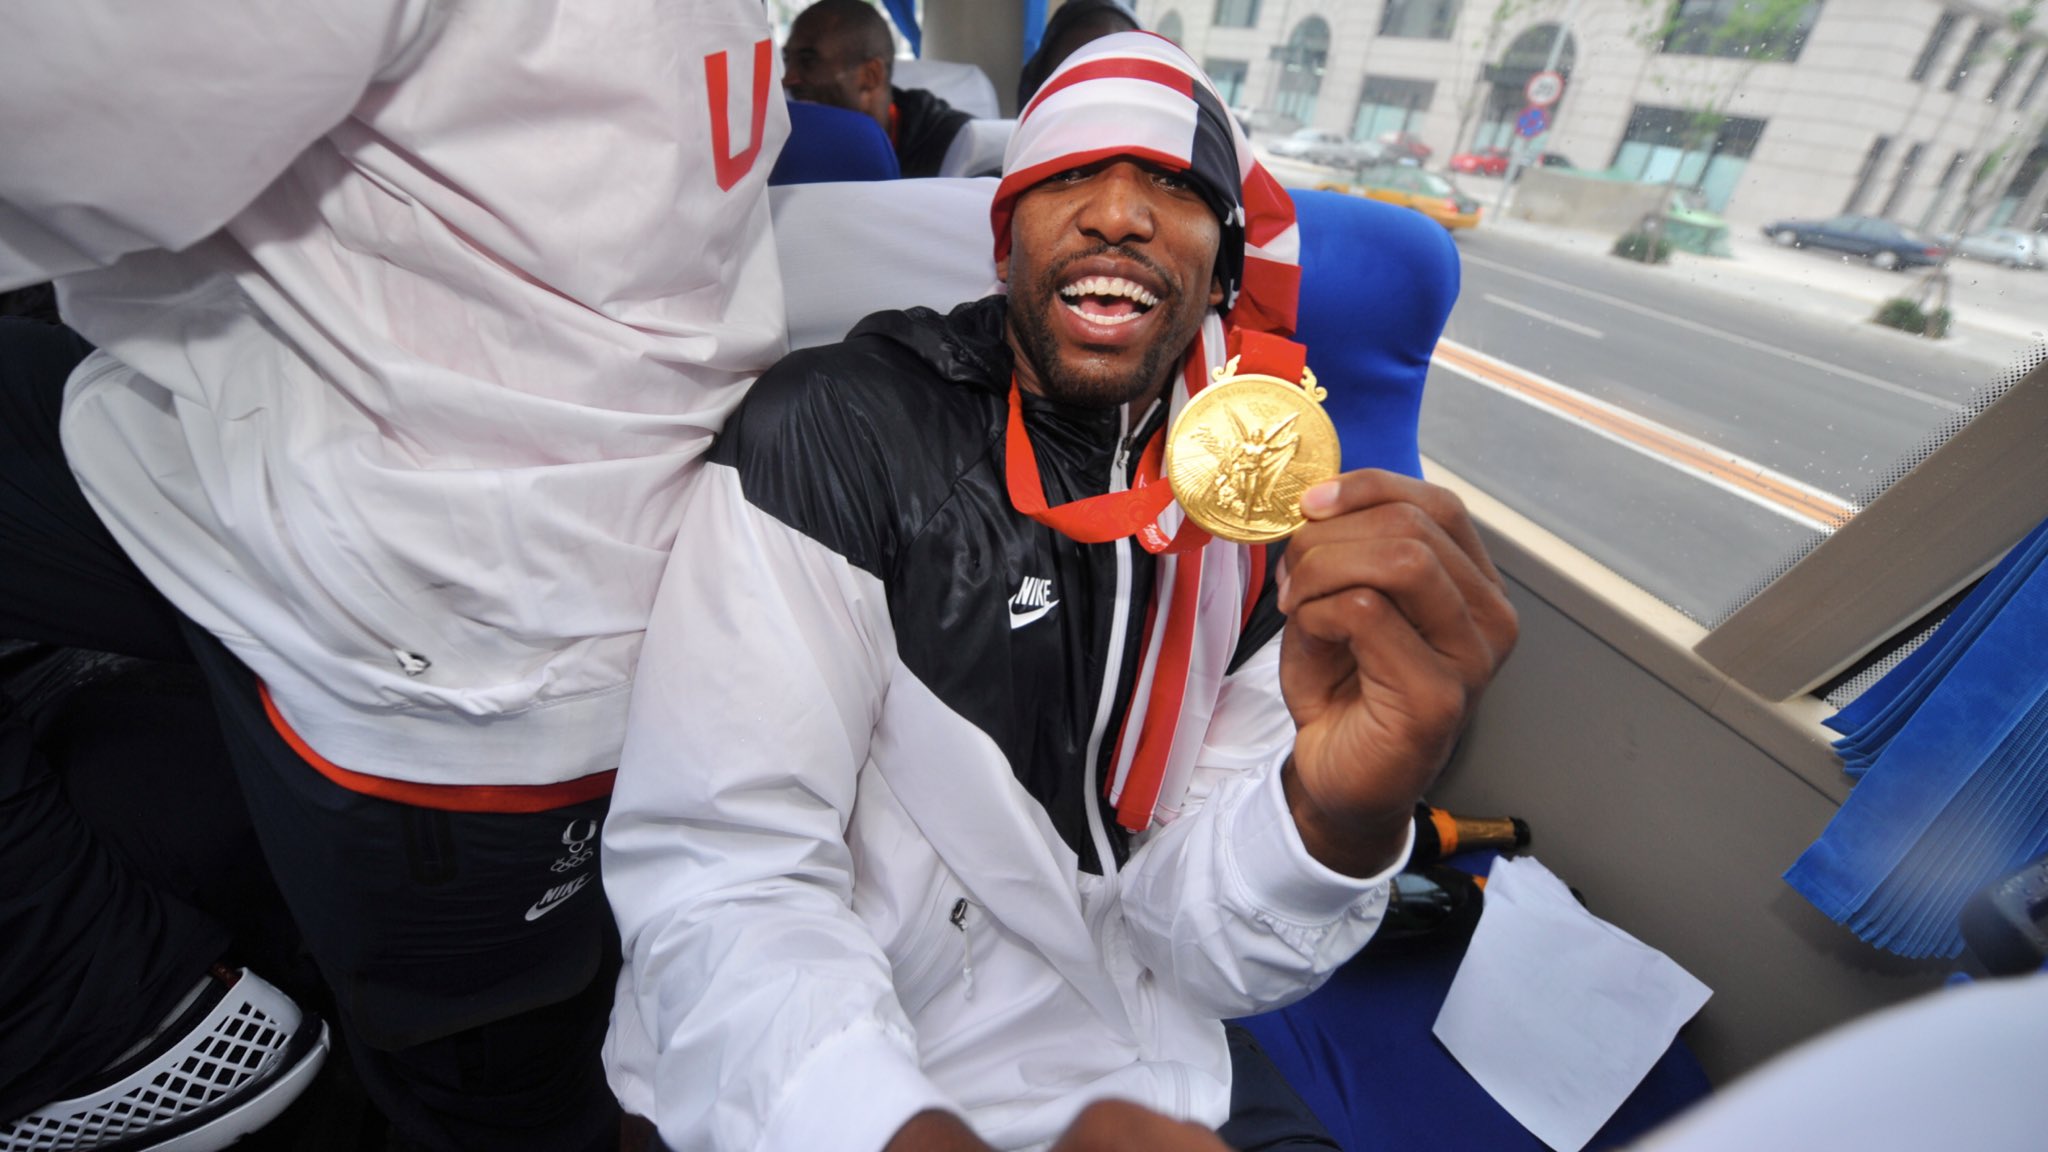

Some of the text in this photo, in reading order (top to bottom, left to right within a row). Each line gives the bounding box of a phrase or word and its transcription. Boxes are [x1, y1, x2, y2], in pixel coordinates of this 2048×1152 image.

[704, 38, 772, 193] U
[1014, 575, 1052, 607] NIKE
[539, 872, 590, 906] NIKE
